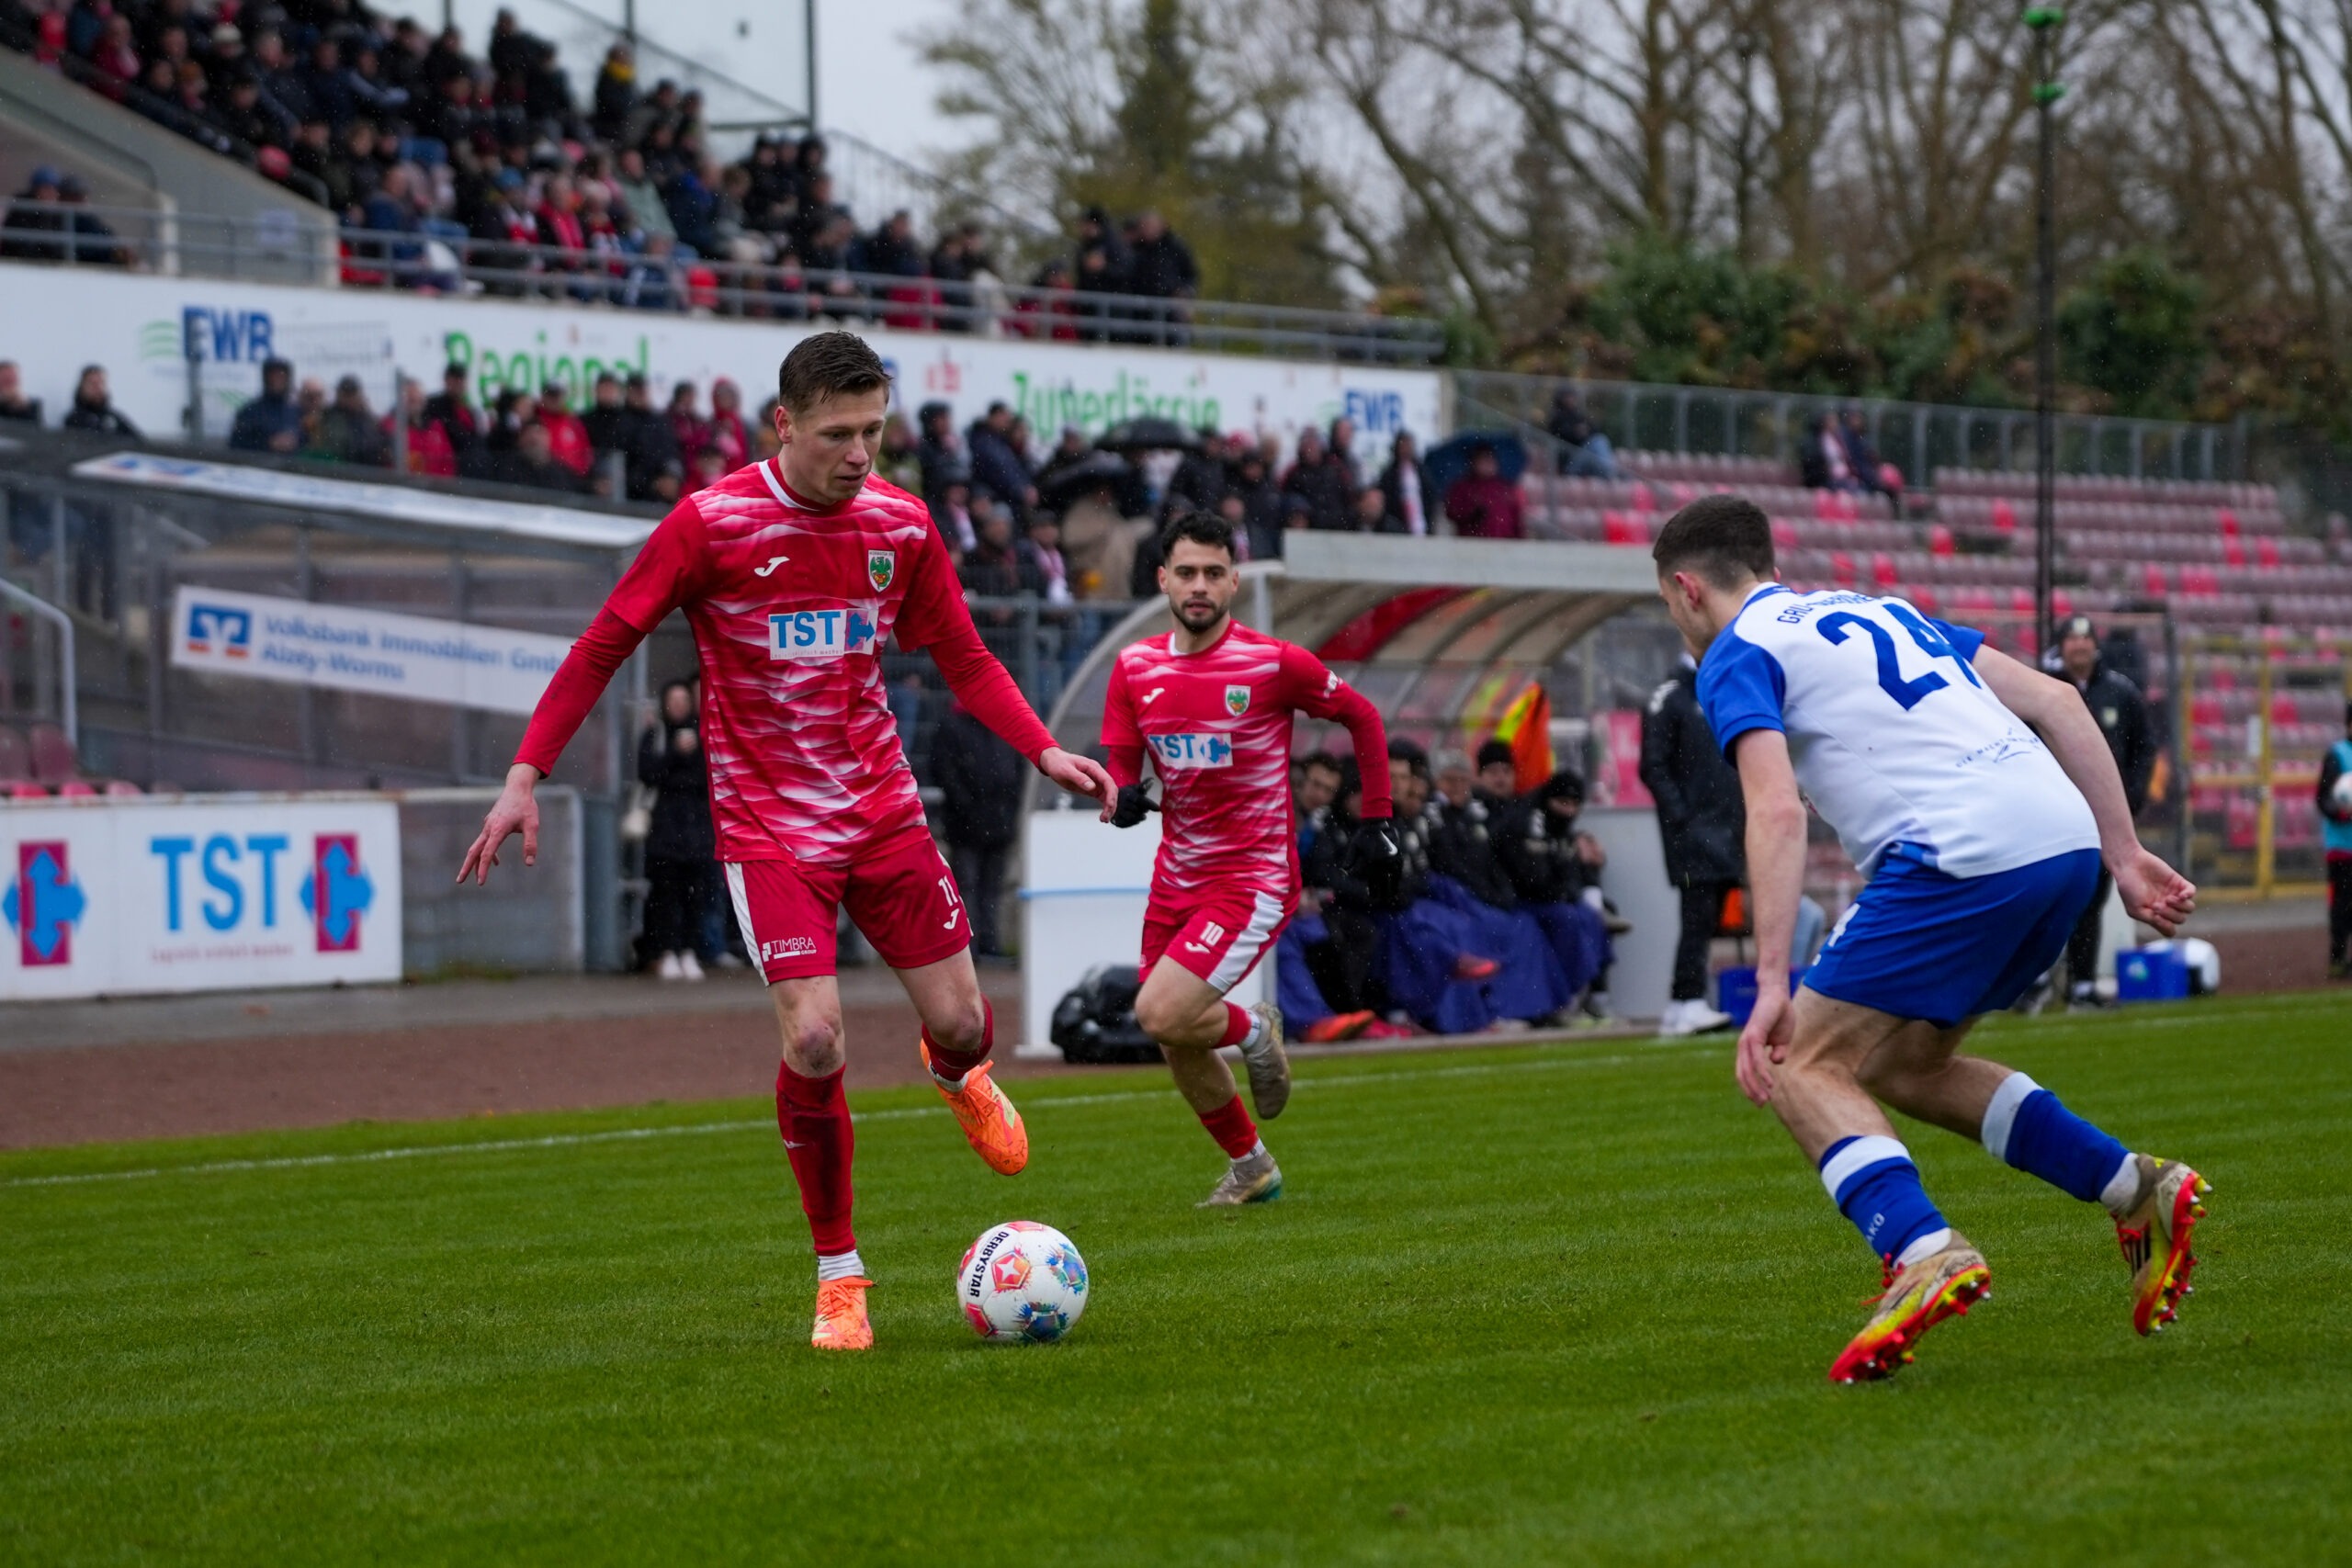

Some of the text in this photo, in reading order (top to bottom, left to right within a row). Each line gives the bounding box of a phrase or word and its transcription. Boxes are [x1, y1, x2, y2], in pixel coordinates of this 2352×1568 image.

[445, 331, 649, 412] Regionl
[265, 615, 562, 672] Volksbank Immobilien Gmb
[770, 612, 841, 649] TST
[1816, 603, 1983, 711] 24
[1149, 734, 1196, 759] TST
[150, 832, 288, 931] TST
[938, 875, 958, 907] 11
[772, 936, 816, 953] TIMBRA
[1200, 920, 1225, 946] 10
[969, 1231, 1010, 1298] DERBYSTAR
